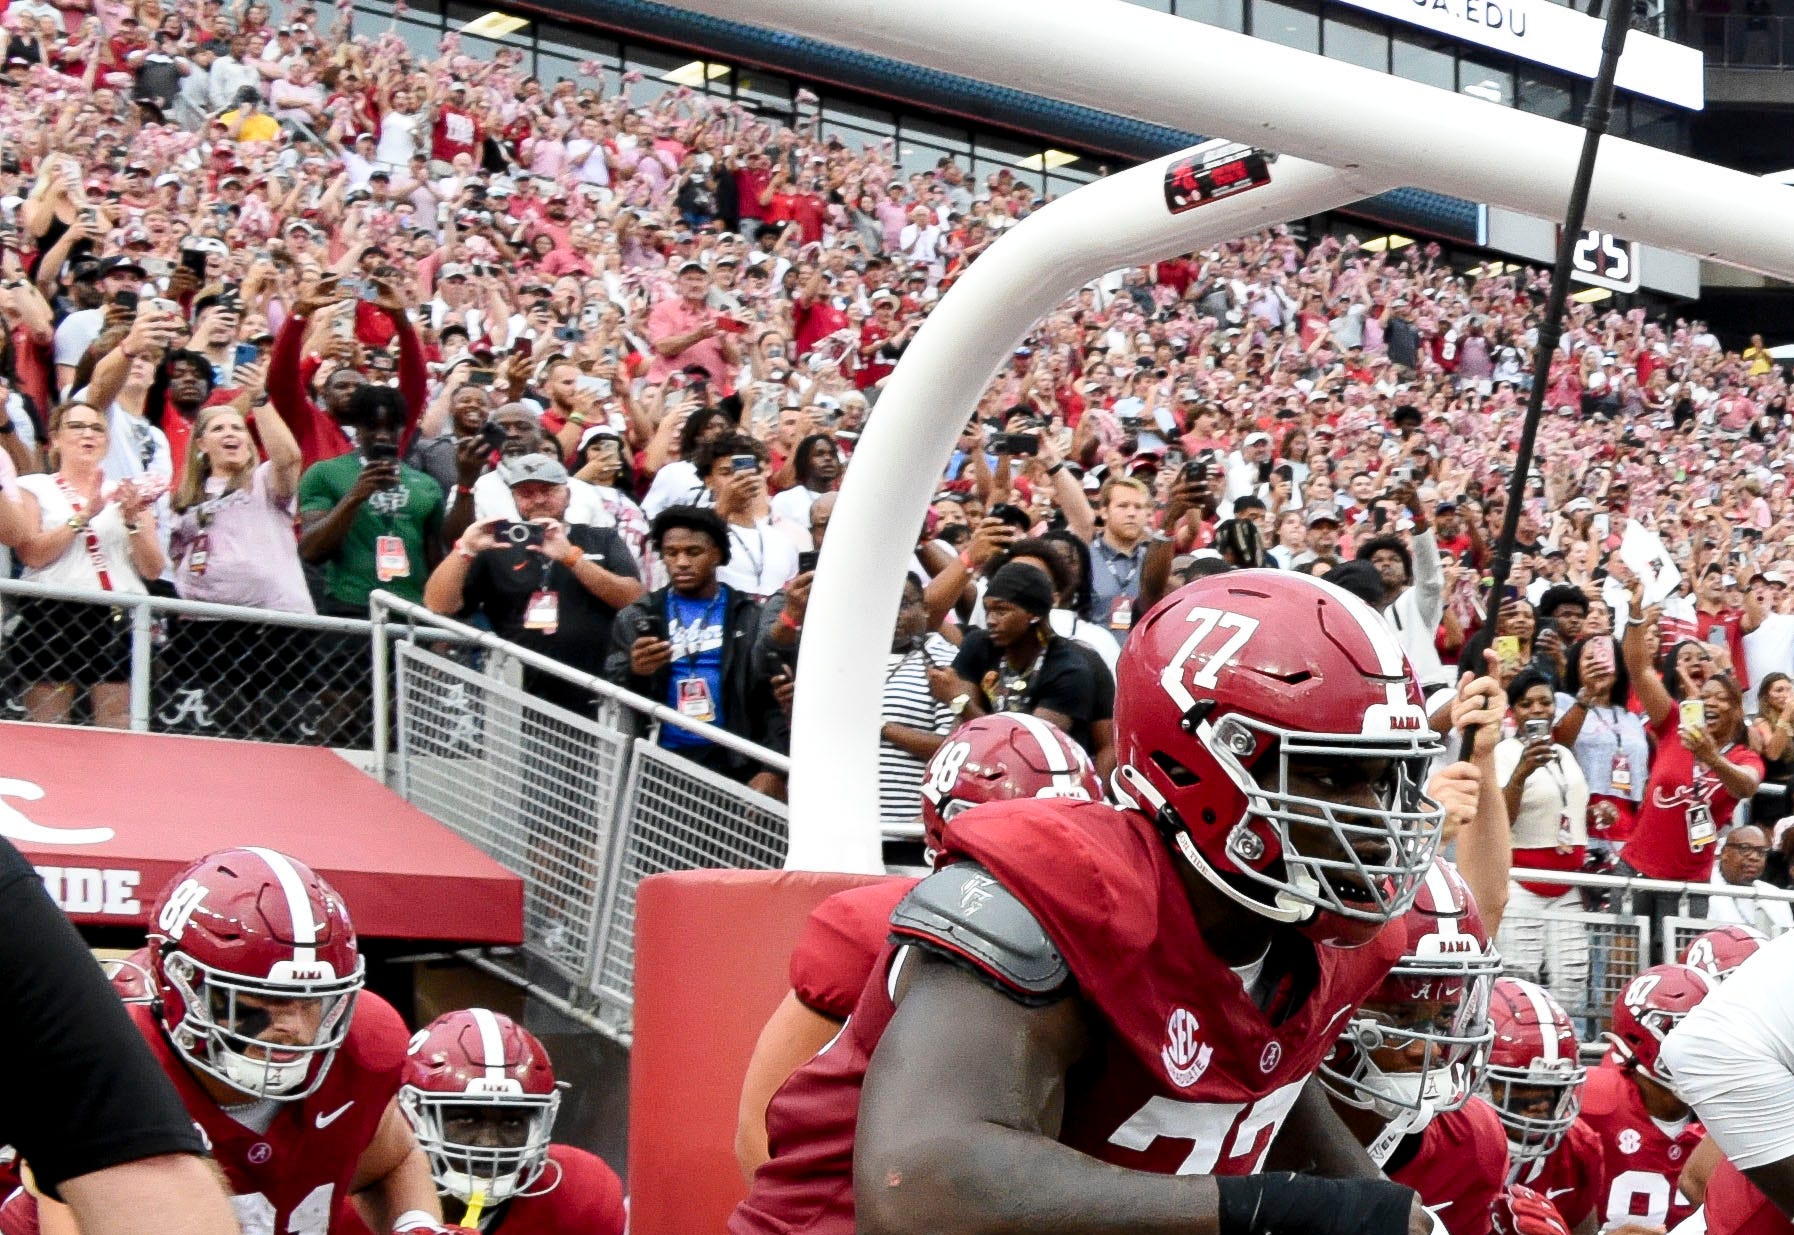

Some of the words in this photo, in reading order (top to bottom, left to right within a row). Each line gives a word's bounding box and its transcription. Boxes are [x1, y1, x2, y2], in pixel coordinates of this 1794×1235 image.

[1413, 0, 1526, 37] A.EDU
[1163, 606, 1260, 690] 77
[1390, 716, 1421, 729] BAMA
[159, 879, 209, 941] 81
[1440, 941, 1471, 952] BAMA
[1168, 1008, 1199, 1066] SEC
